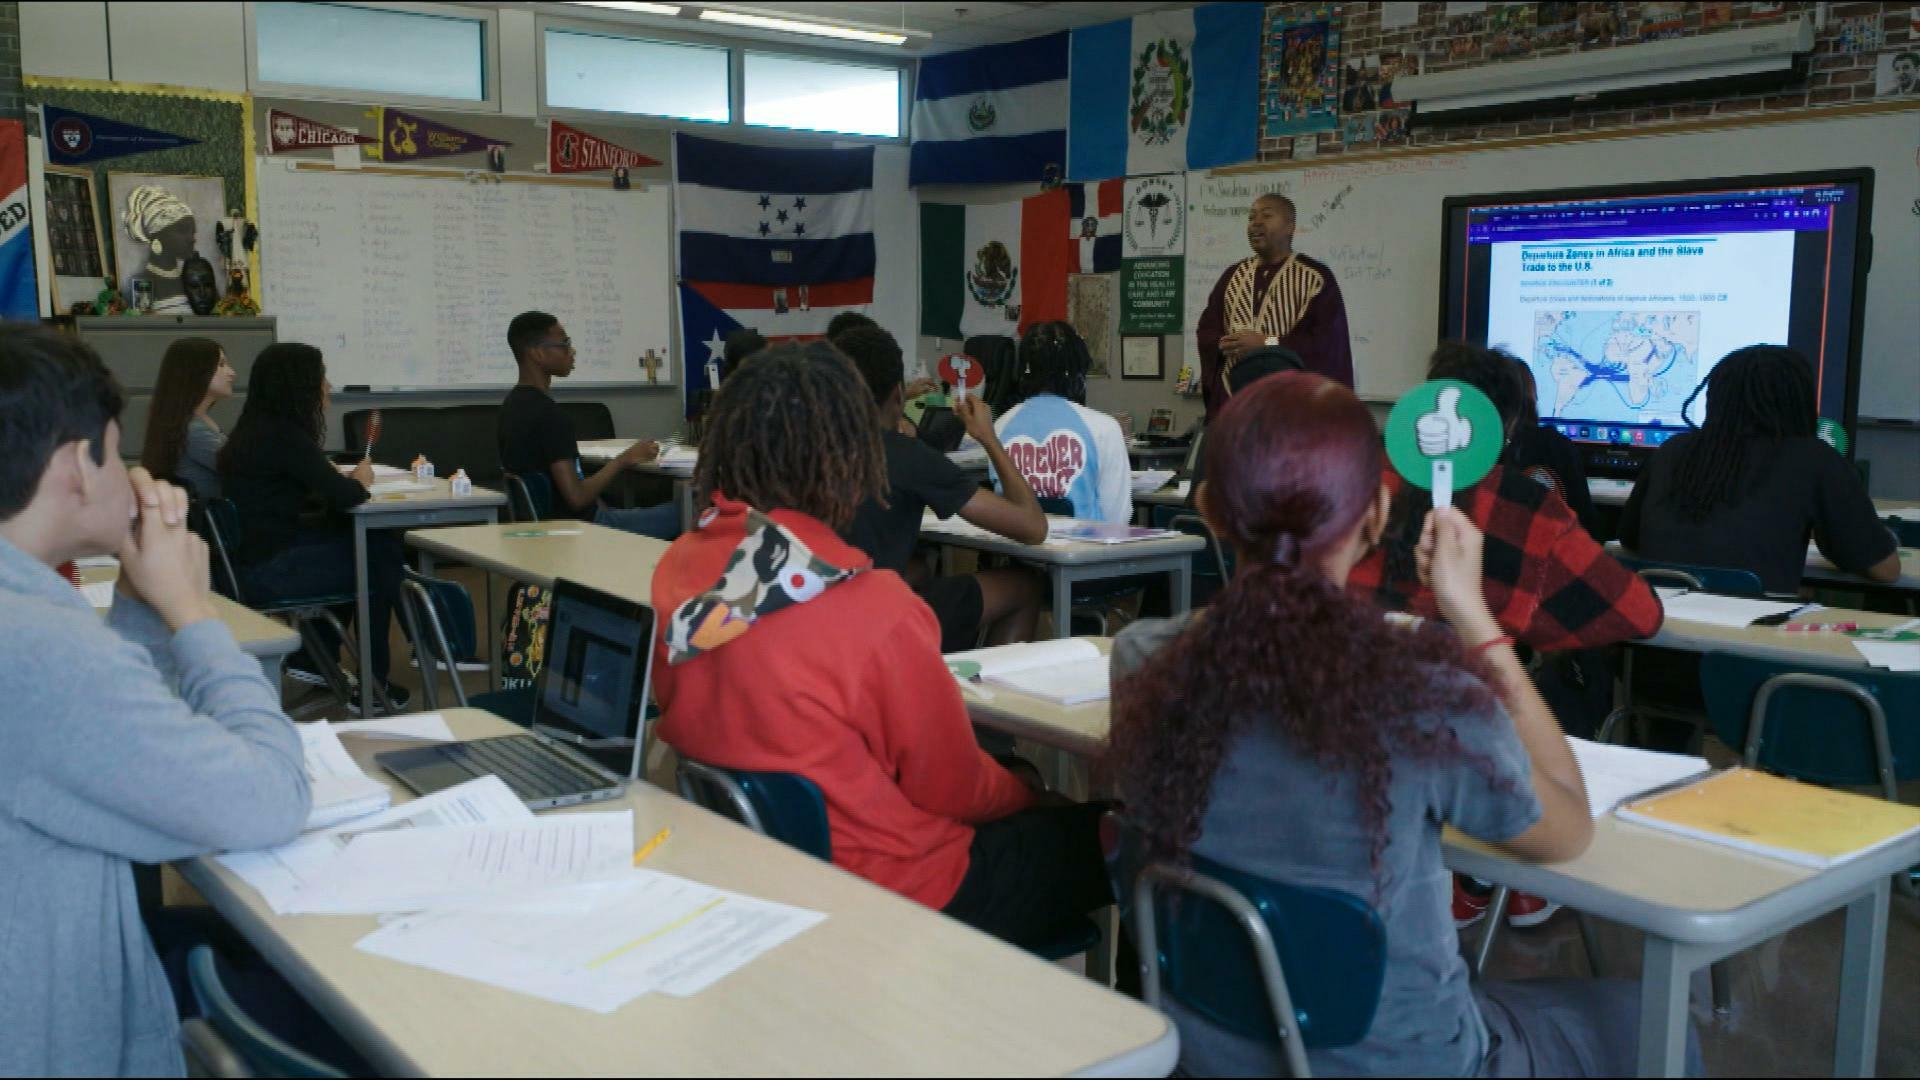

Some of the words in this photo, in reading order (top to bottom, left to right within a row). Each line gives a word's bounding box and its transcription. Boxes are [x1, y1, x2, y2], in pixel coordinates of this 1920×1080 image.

[298, 128, 354, 144] CHICAGO
[582, 138, 638, 167] STANFORD
[1607, 247, 1636, 258] Africa
[1638, 246, 1656, 257] and
[1658, 246, 1674, 257] the
[1558, 262, 1573, 272] the
[1004, 435, 1083, 475] OREVER
